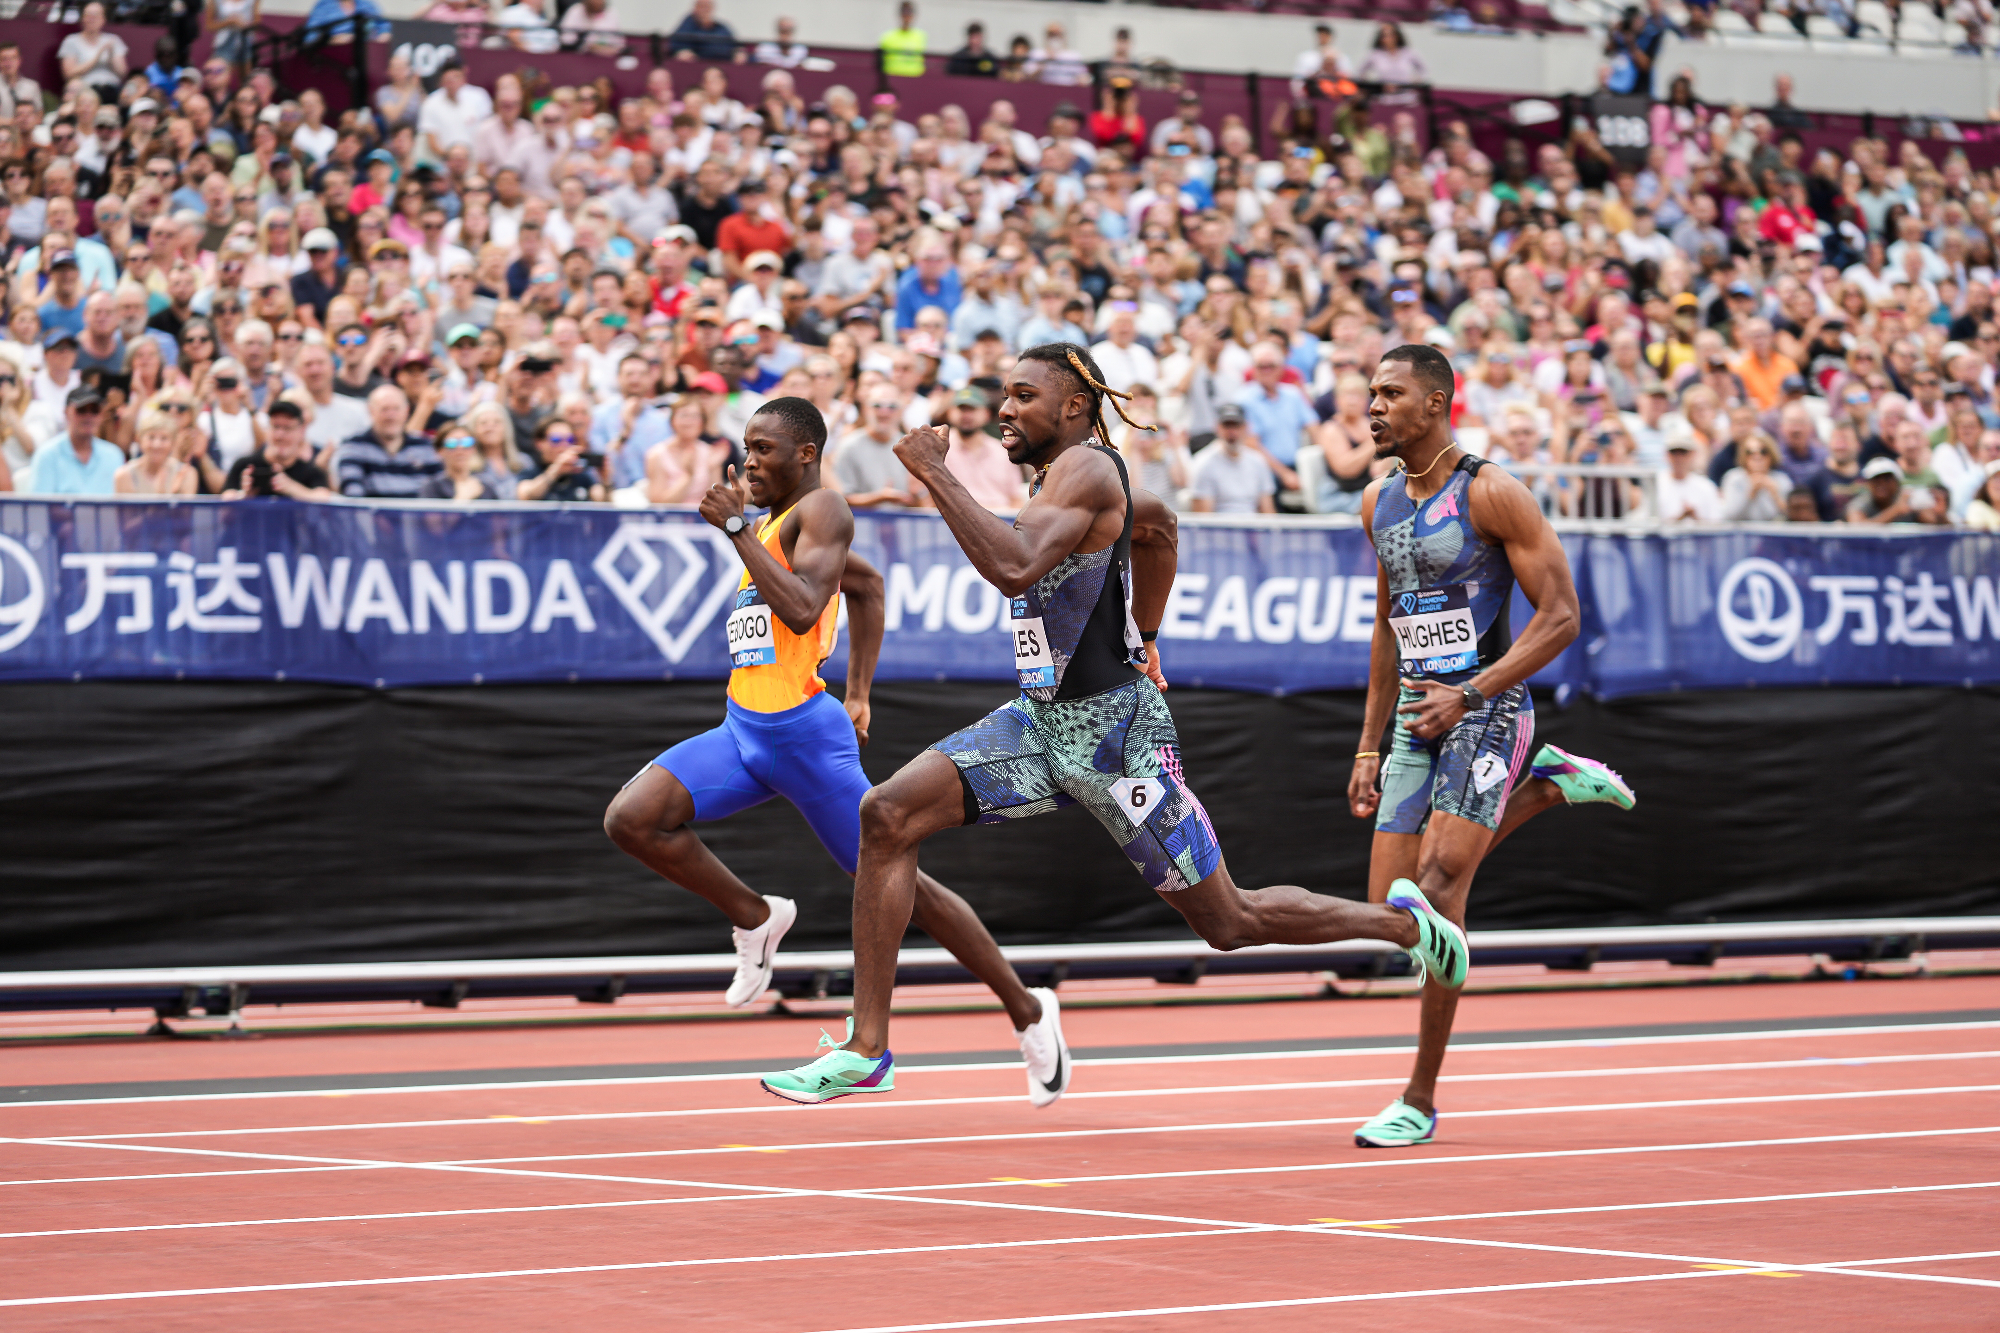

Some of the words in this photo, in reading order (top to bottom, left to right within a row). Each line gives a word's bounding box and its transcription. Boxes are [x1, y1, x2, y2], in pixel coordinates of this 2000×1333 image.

[61, 547, 262, 634] 万达
[266, 552, 596, 634] WANDA
[1163, 573, 1377, 644] EAGUE
[1808, 572, 1953, 646] 万达
[1398, 618, 1470, 649] HUGHES
[1422, 656, 1466, 671] LONDON
[1131, 785, 1146, 808] 6
